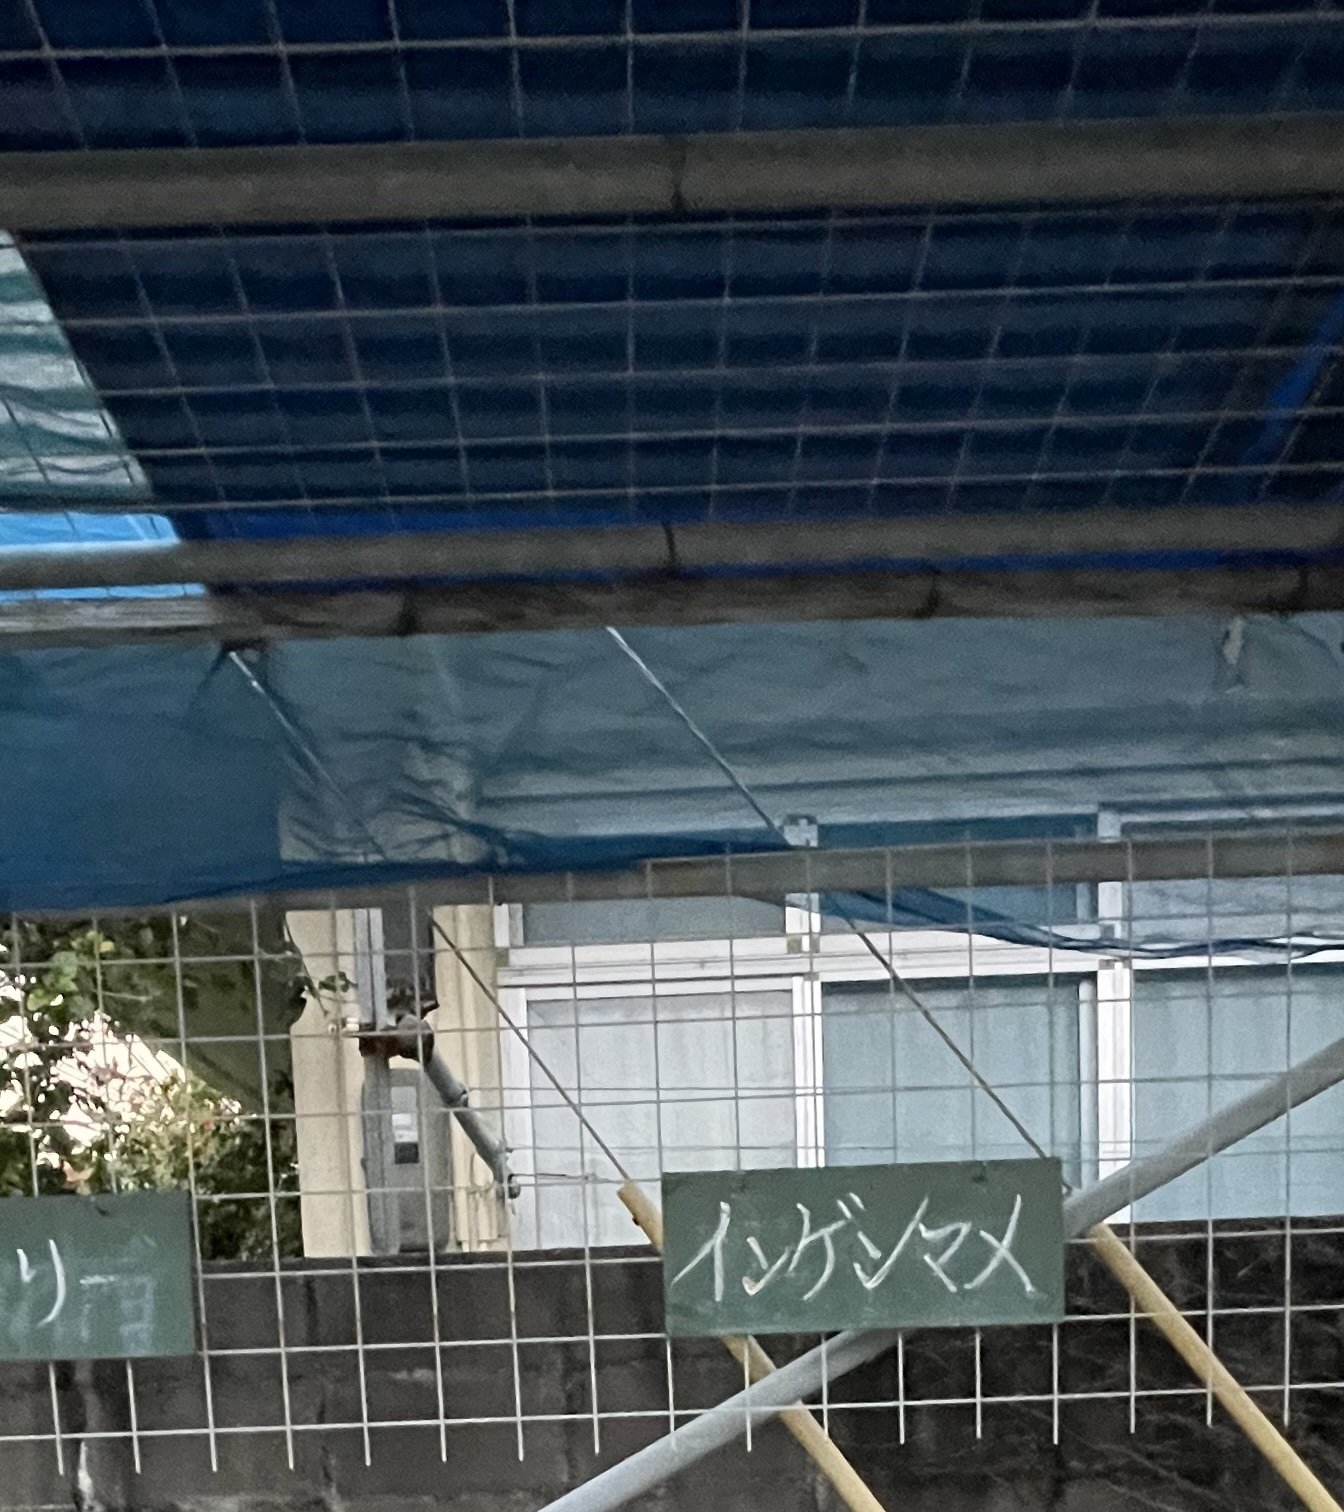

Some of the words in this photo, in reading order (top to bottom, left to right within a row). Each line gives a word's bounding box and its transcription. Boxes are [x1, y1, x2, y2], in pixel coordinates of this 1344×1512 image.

[670, 1191, 1040, 1302] インゲンマメ
